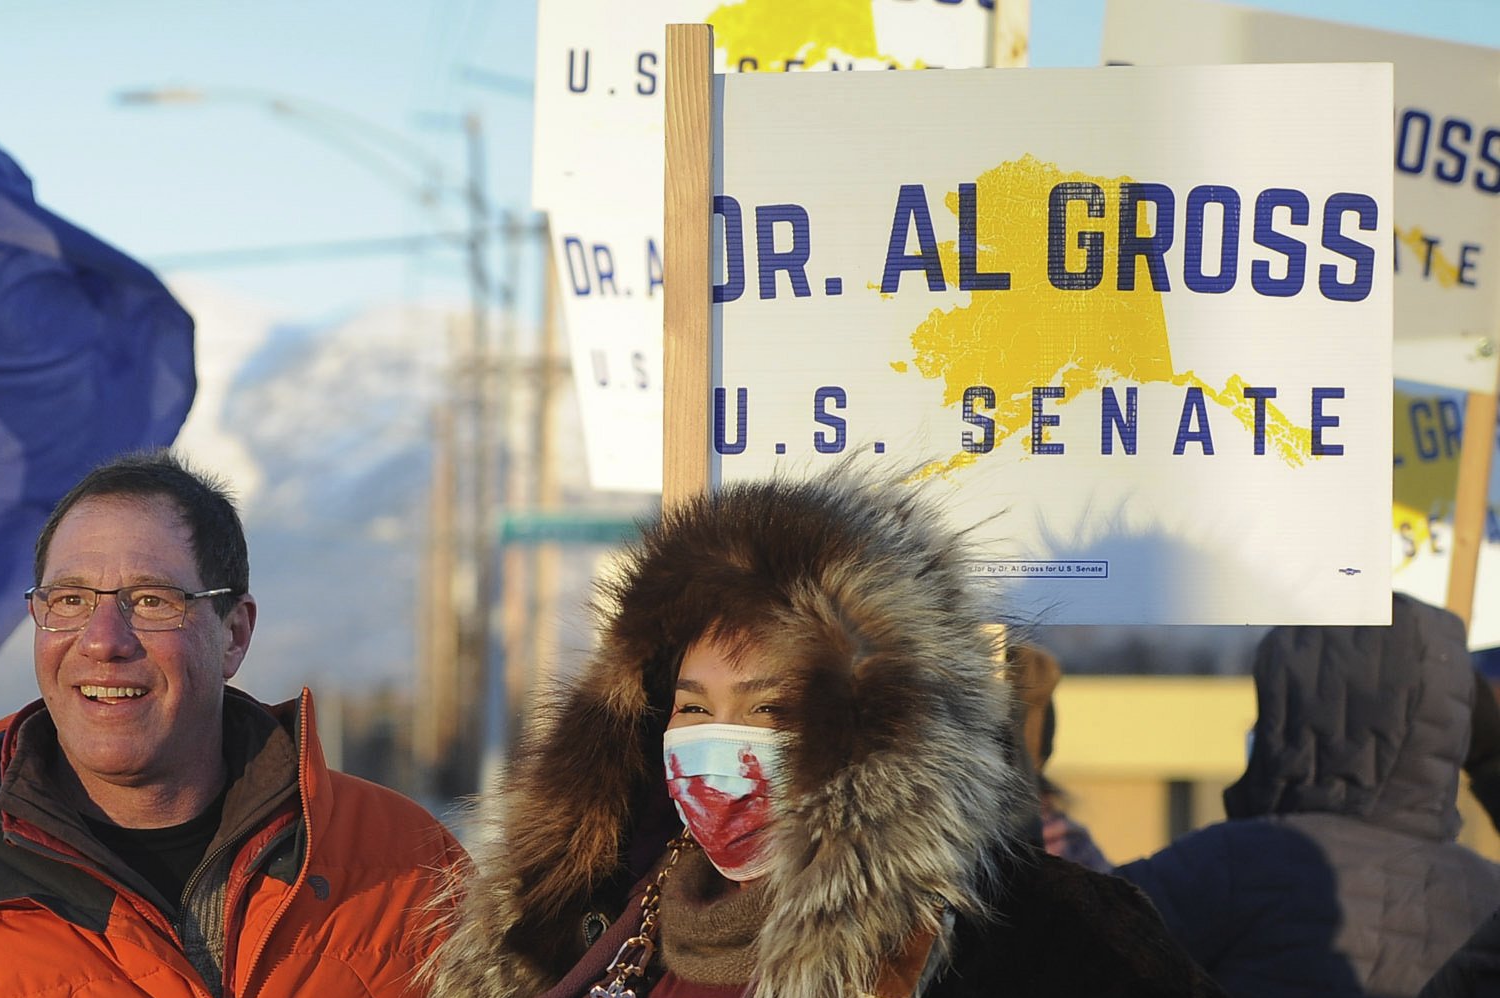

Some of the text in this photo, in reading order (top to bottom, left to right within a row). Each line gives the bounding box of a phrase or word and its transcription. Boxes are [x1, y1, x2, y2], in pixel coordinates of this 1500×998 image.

[568, 49, 657, 95] U.S
[1396, 110, 1500, 194] OSS
[880, 183, 1010, 293] AL
[1047, 181, 1379, 302] GROSS
[713, 386, 1345, 456] U.S. SENATE
